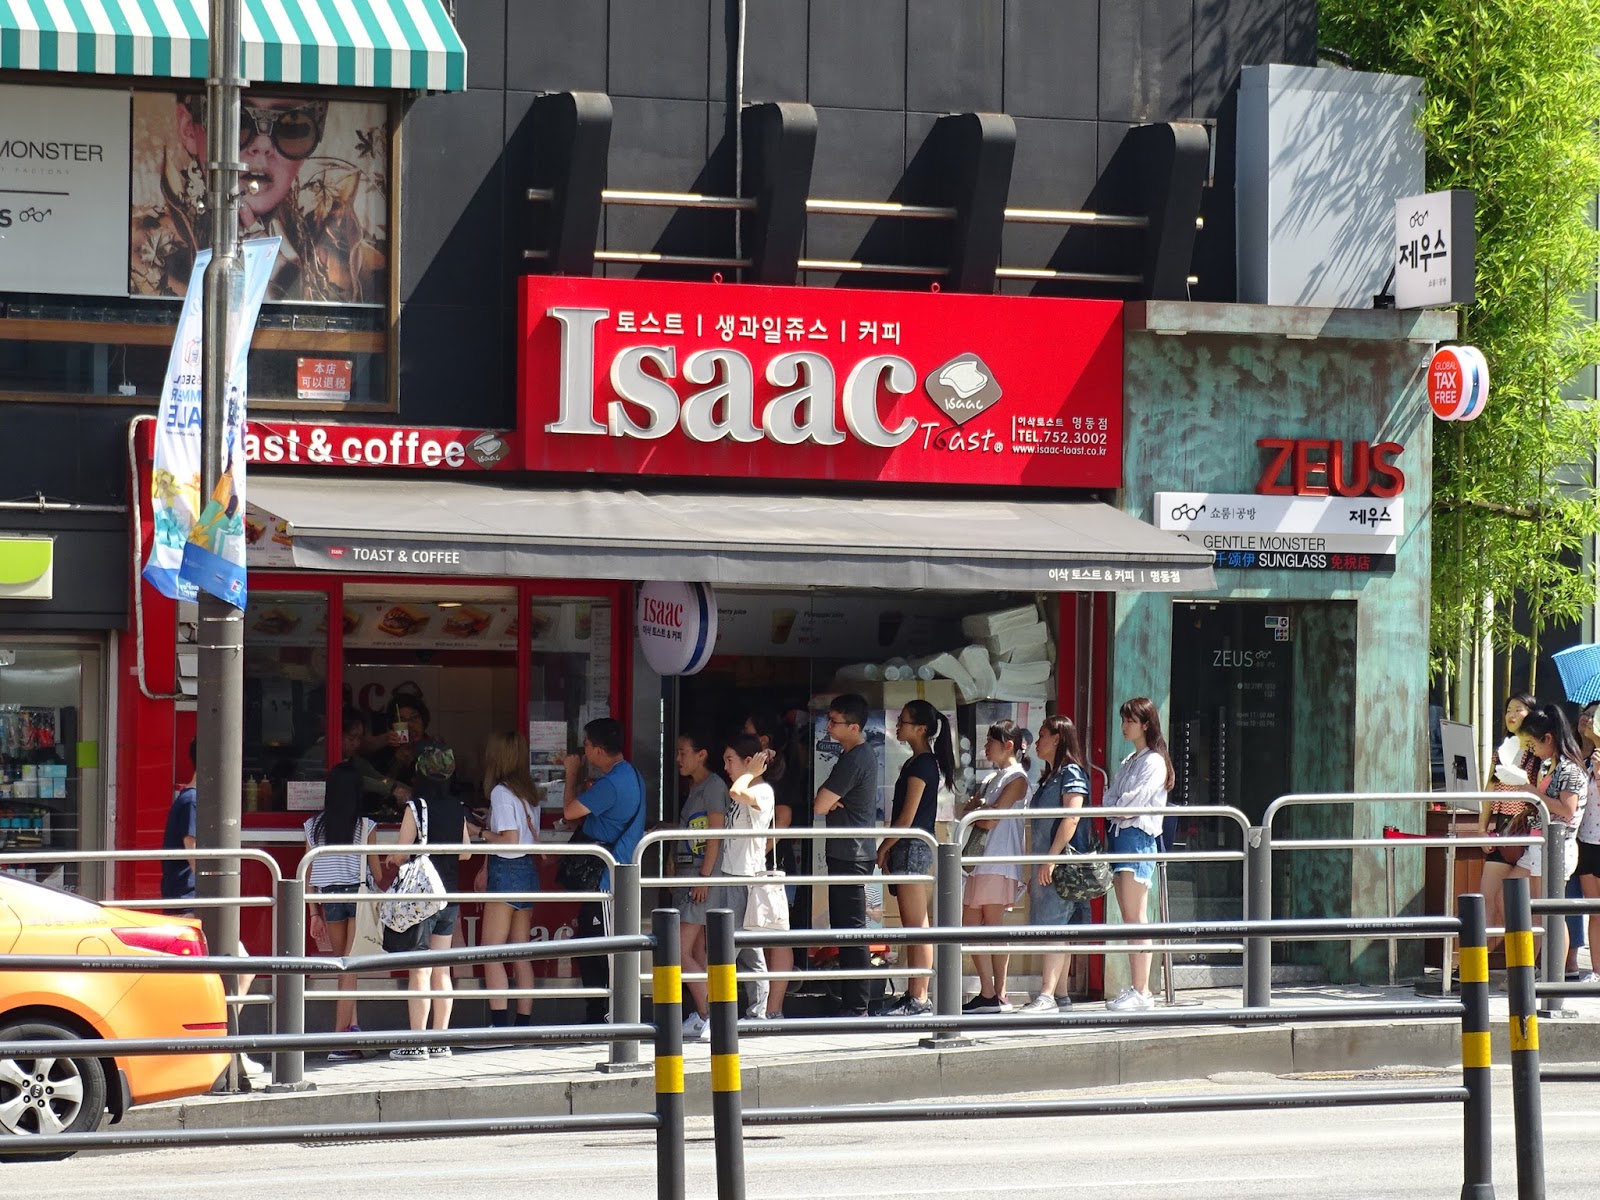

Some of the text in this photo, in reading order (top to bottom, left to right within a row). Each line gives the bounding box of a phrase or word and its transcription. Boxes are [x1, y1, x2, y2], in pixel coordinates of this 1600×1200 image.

[1399, 229, 1447, 273] 제우스
[616, 311, 901, 345] 토스트 생과일쥬스 커피
[314, 362, 337, 375] 本店
[1434, 361, 1458, 371] GLOBAL
[545, 306, 918, 447] Isaac
[1434, 371, 1457, 390] TAX
[945, 398, 984, 410] Isaac
[1434, 390, 1457, 405] FREE
[1017, 416, 1108, 430] 이삭토스트 명동점
[920, 421, 996, 452] Toast
[245, 428, 466, 467] ast & coffee
[1012, 445, 1107, 456] www.isaac-toast.co.kr
[1256, 437, 1406, 498] ZEUS
[1349, 506, 1392, 528] 제우스
[1203, 534, 1326, 551] GENTLE MONSTER
[353, 547, 395, 562] TOAST
[398, 550, 409, 562] &
[412, 550, 460, 564] COFFEE
[1258, 553, 1327, 568] SUNGLASS
[1048, 568, 1181, 583] 이삭 토스트 & 커피 명동점
[643, 597, 683, 628] Isaac
[1213, 650, 1254, 668] ZEUS
